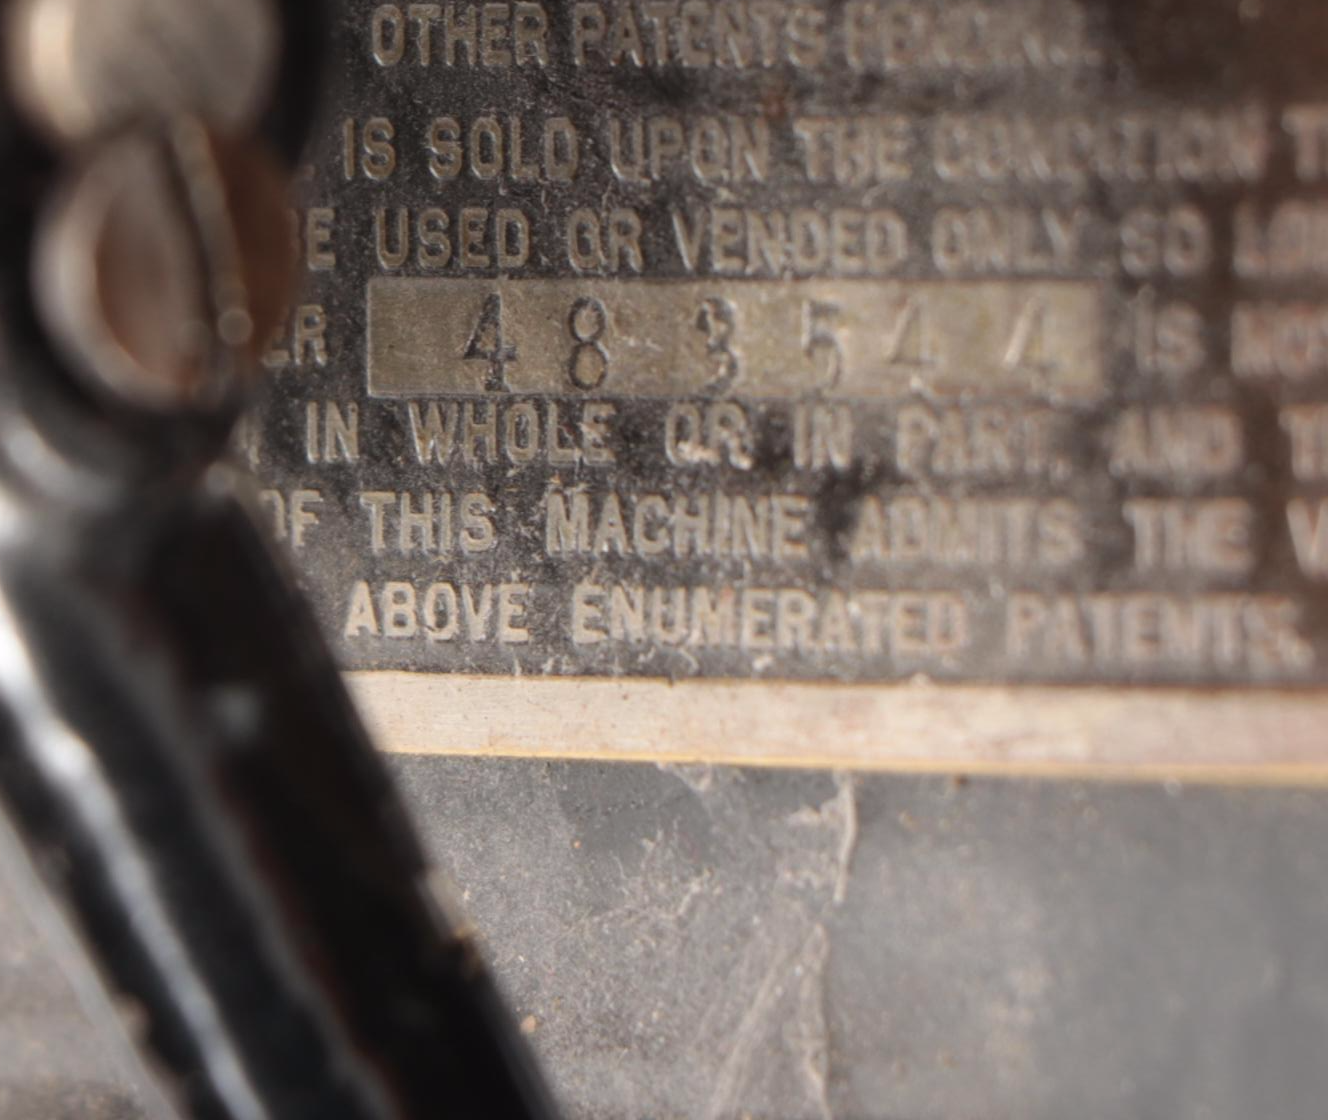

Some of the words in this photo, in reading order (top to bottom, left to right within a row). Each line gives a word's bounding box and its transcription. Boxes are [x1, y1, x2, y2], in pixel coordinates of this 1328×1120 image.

[372, 0, 550, 68] OTHER
[342, 116, 398, 180] IS
[428, 116, 578, 180] SOLD
[610, 116, 770, 182] UPON
[792, 116, 914, 184] THE
[372, 206, 532, 272] USED
[568, 208, 646, 272] OR
[672, 206, 910, 276] VENDED
[930, 202, 1092, 276] ONLY
[1119, 202, 1212, 276] SO
[304, 400, 362, 464] IN
[406, 402, 616, 466] WHOLE
[664, 402, 752, 470] OR
[792, 402, 856, 472] IN
[358, 490, 496, 554] THIS
[542, 490, 810, 558] MACHINE
[344, 580, 530, 642] ABOVE
[570, 586, 968, 652] ENUMERATED
